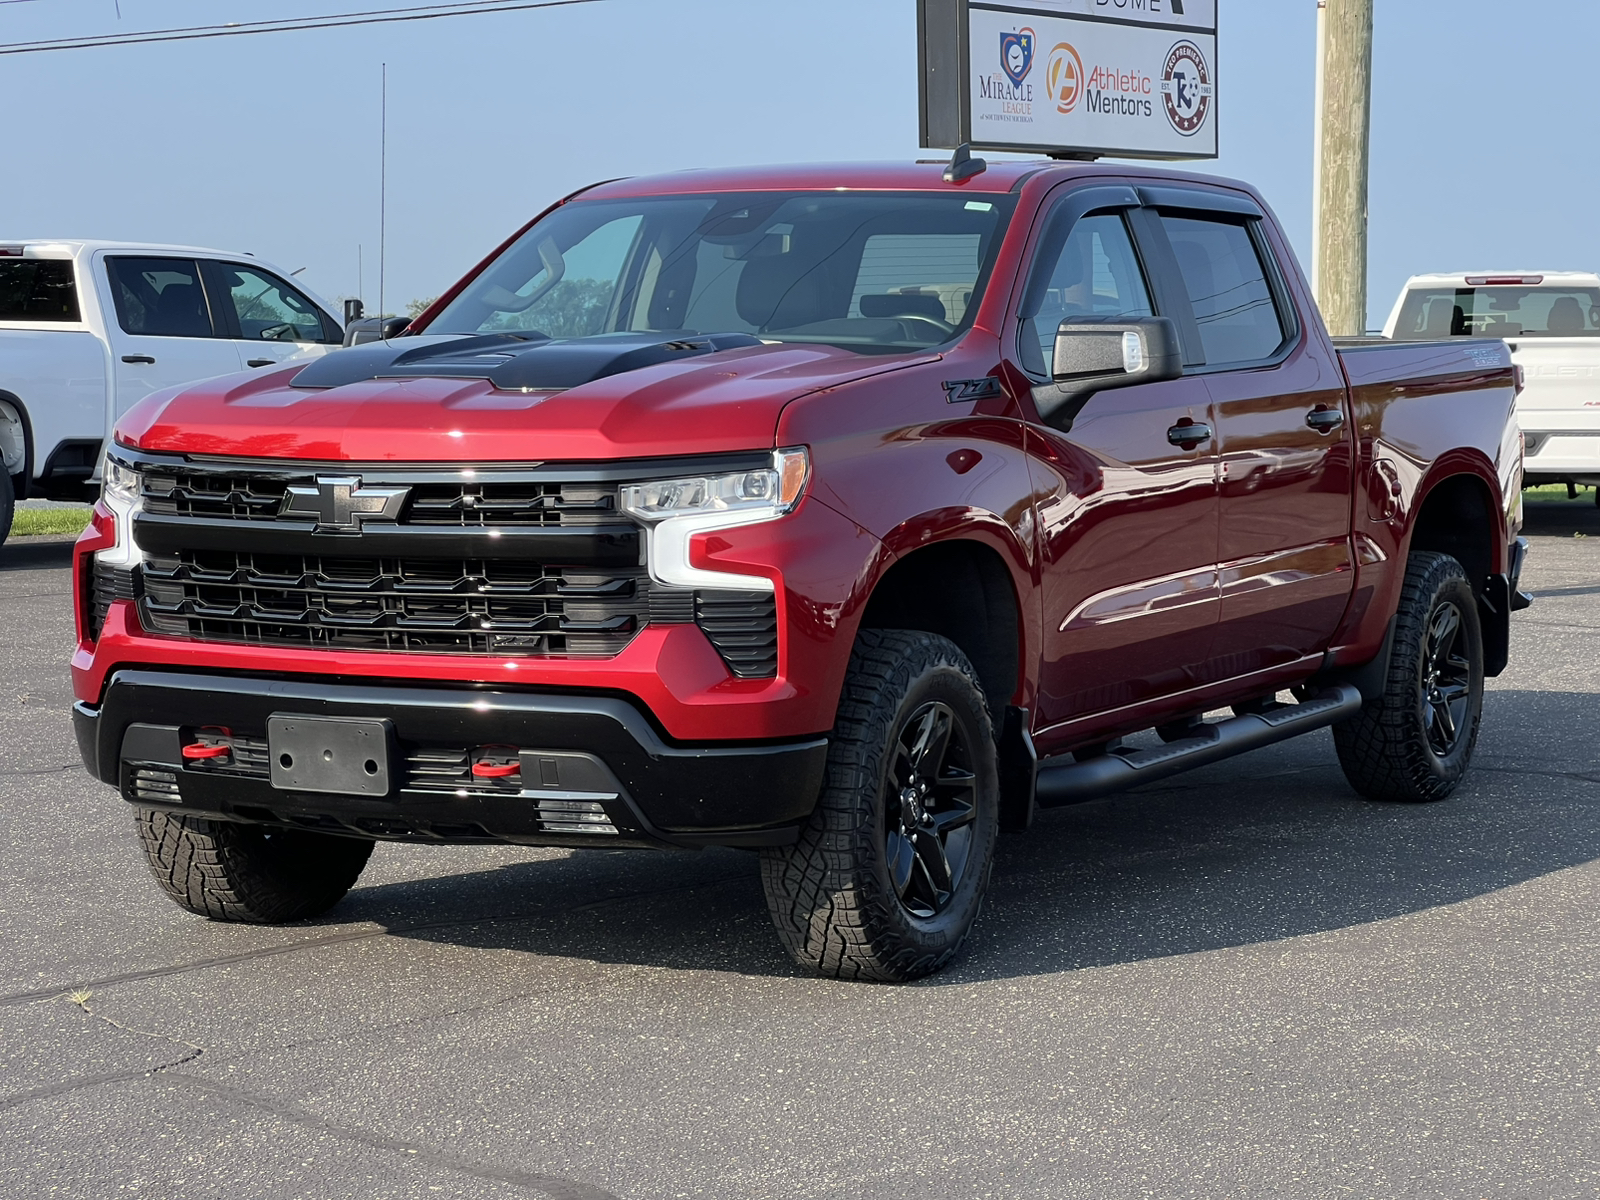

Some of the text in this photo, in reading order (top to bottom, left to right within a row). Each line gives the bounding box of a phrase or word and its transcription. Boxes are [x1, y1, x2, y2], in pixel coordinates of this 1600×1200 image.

[1097, 0, 1161, 12] ME
[1166, 47, 1206, 77] TKO PREMIER SC
[992, 72, 1003, 81] THE
[1086, 65, 1151, 94] Athletic
[979, 75, 1033, 102] MIRACLE
[1161, 82, 1171, 91] EST.
[1200, 86, 1212, 94] 1983
[1002, 101, 1032, 115] LEAGUE
[1086, 88, 1152, 117] Mentors
[1471, 357, 1501, 368] BOSS
